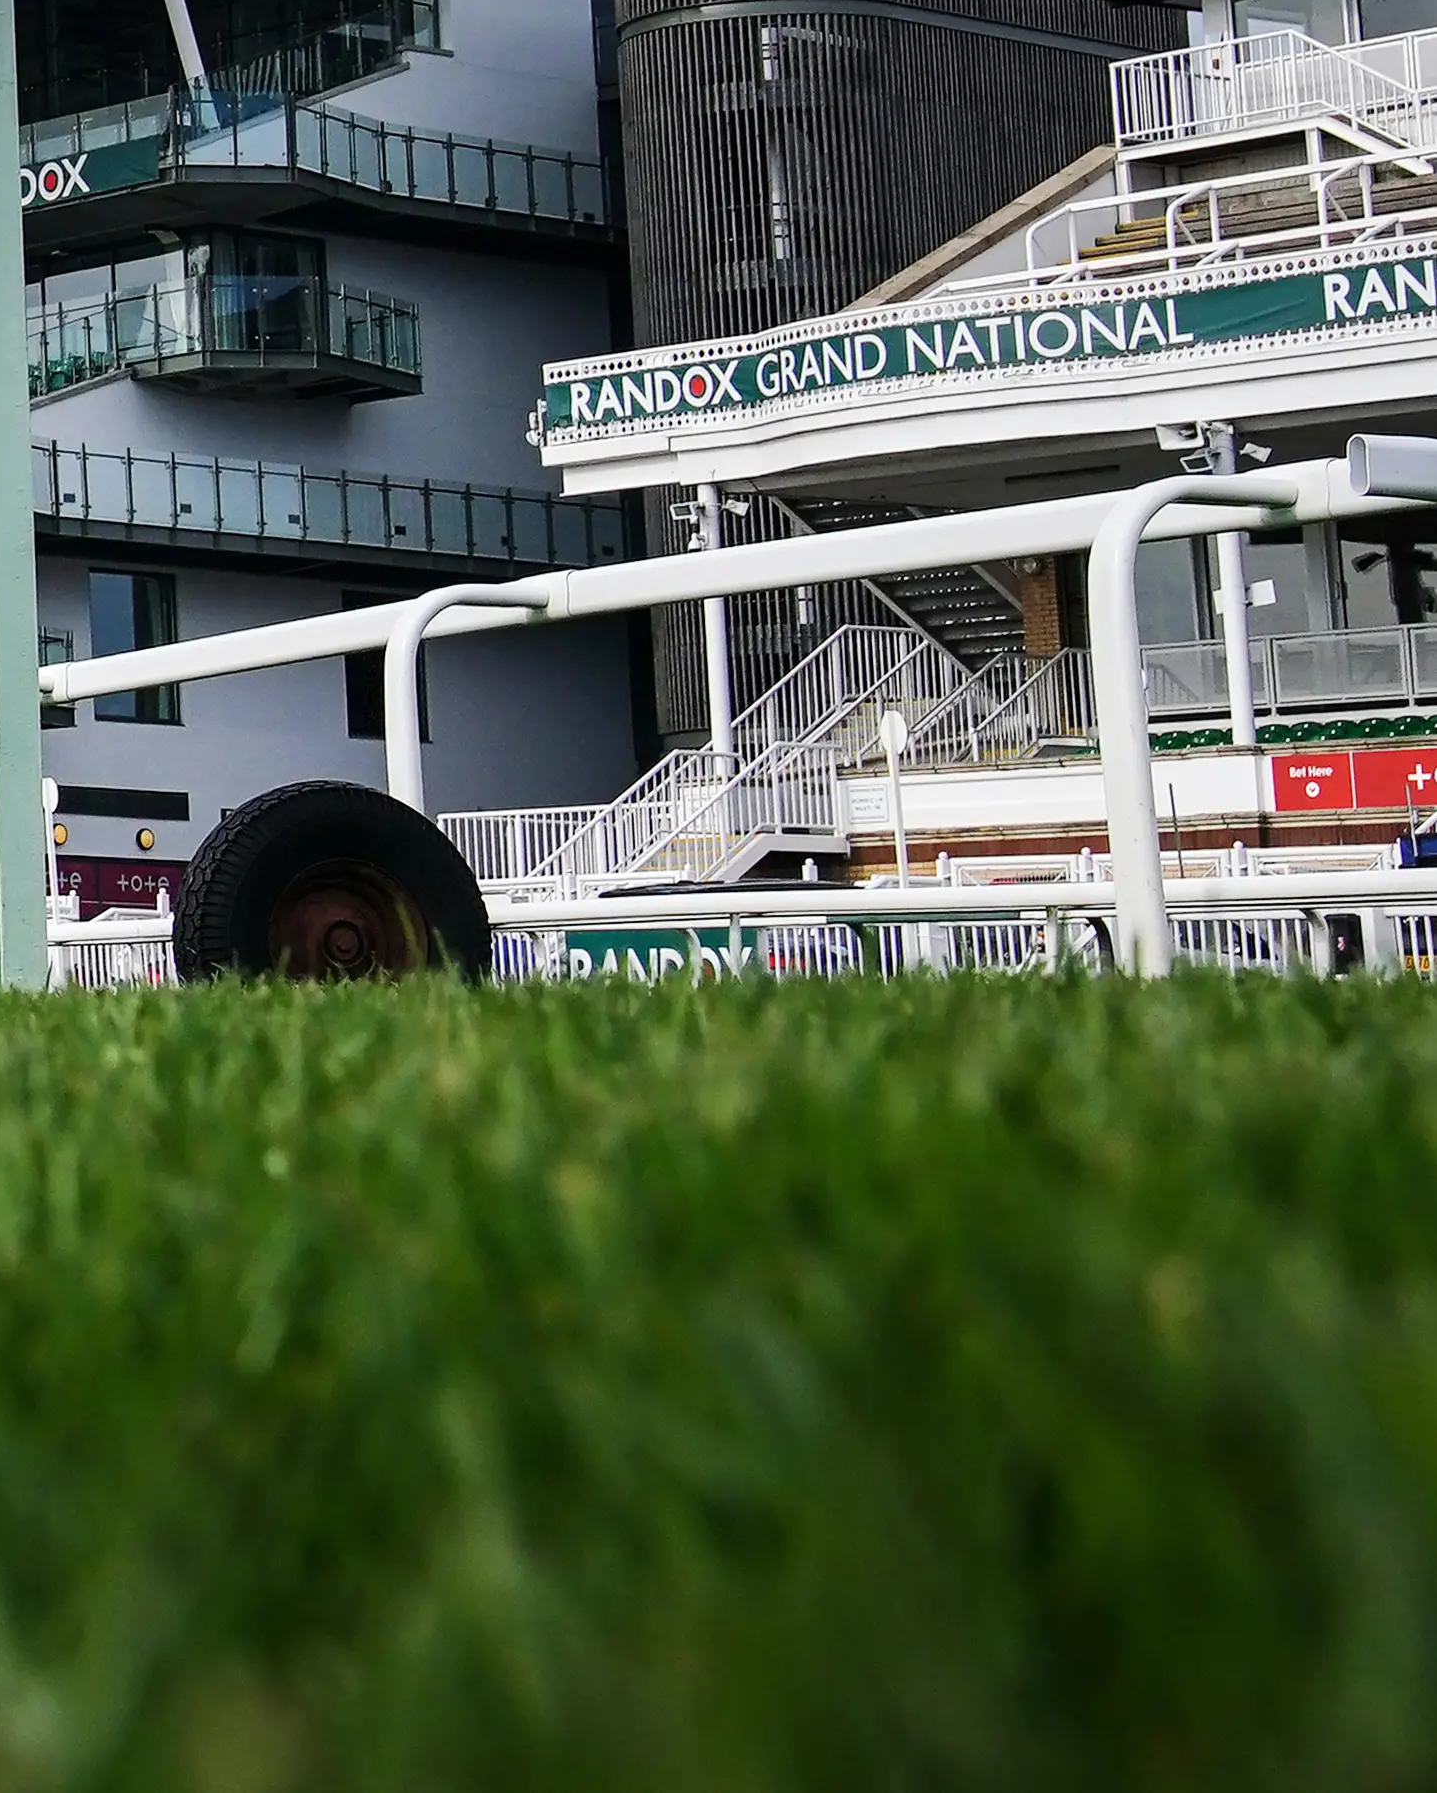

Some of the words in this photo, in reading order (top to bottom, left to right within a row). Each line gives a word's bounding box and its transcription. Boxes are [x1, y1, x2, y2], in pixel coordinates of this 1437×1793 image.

[20, 153, 90, 206] DOX
[569, 357, 742, 422] RANDOX
[756, 330, 887, 396] GRAND
[905, 298, 1194, 373] NATIONAL
